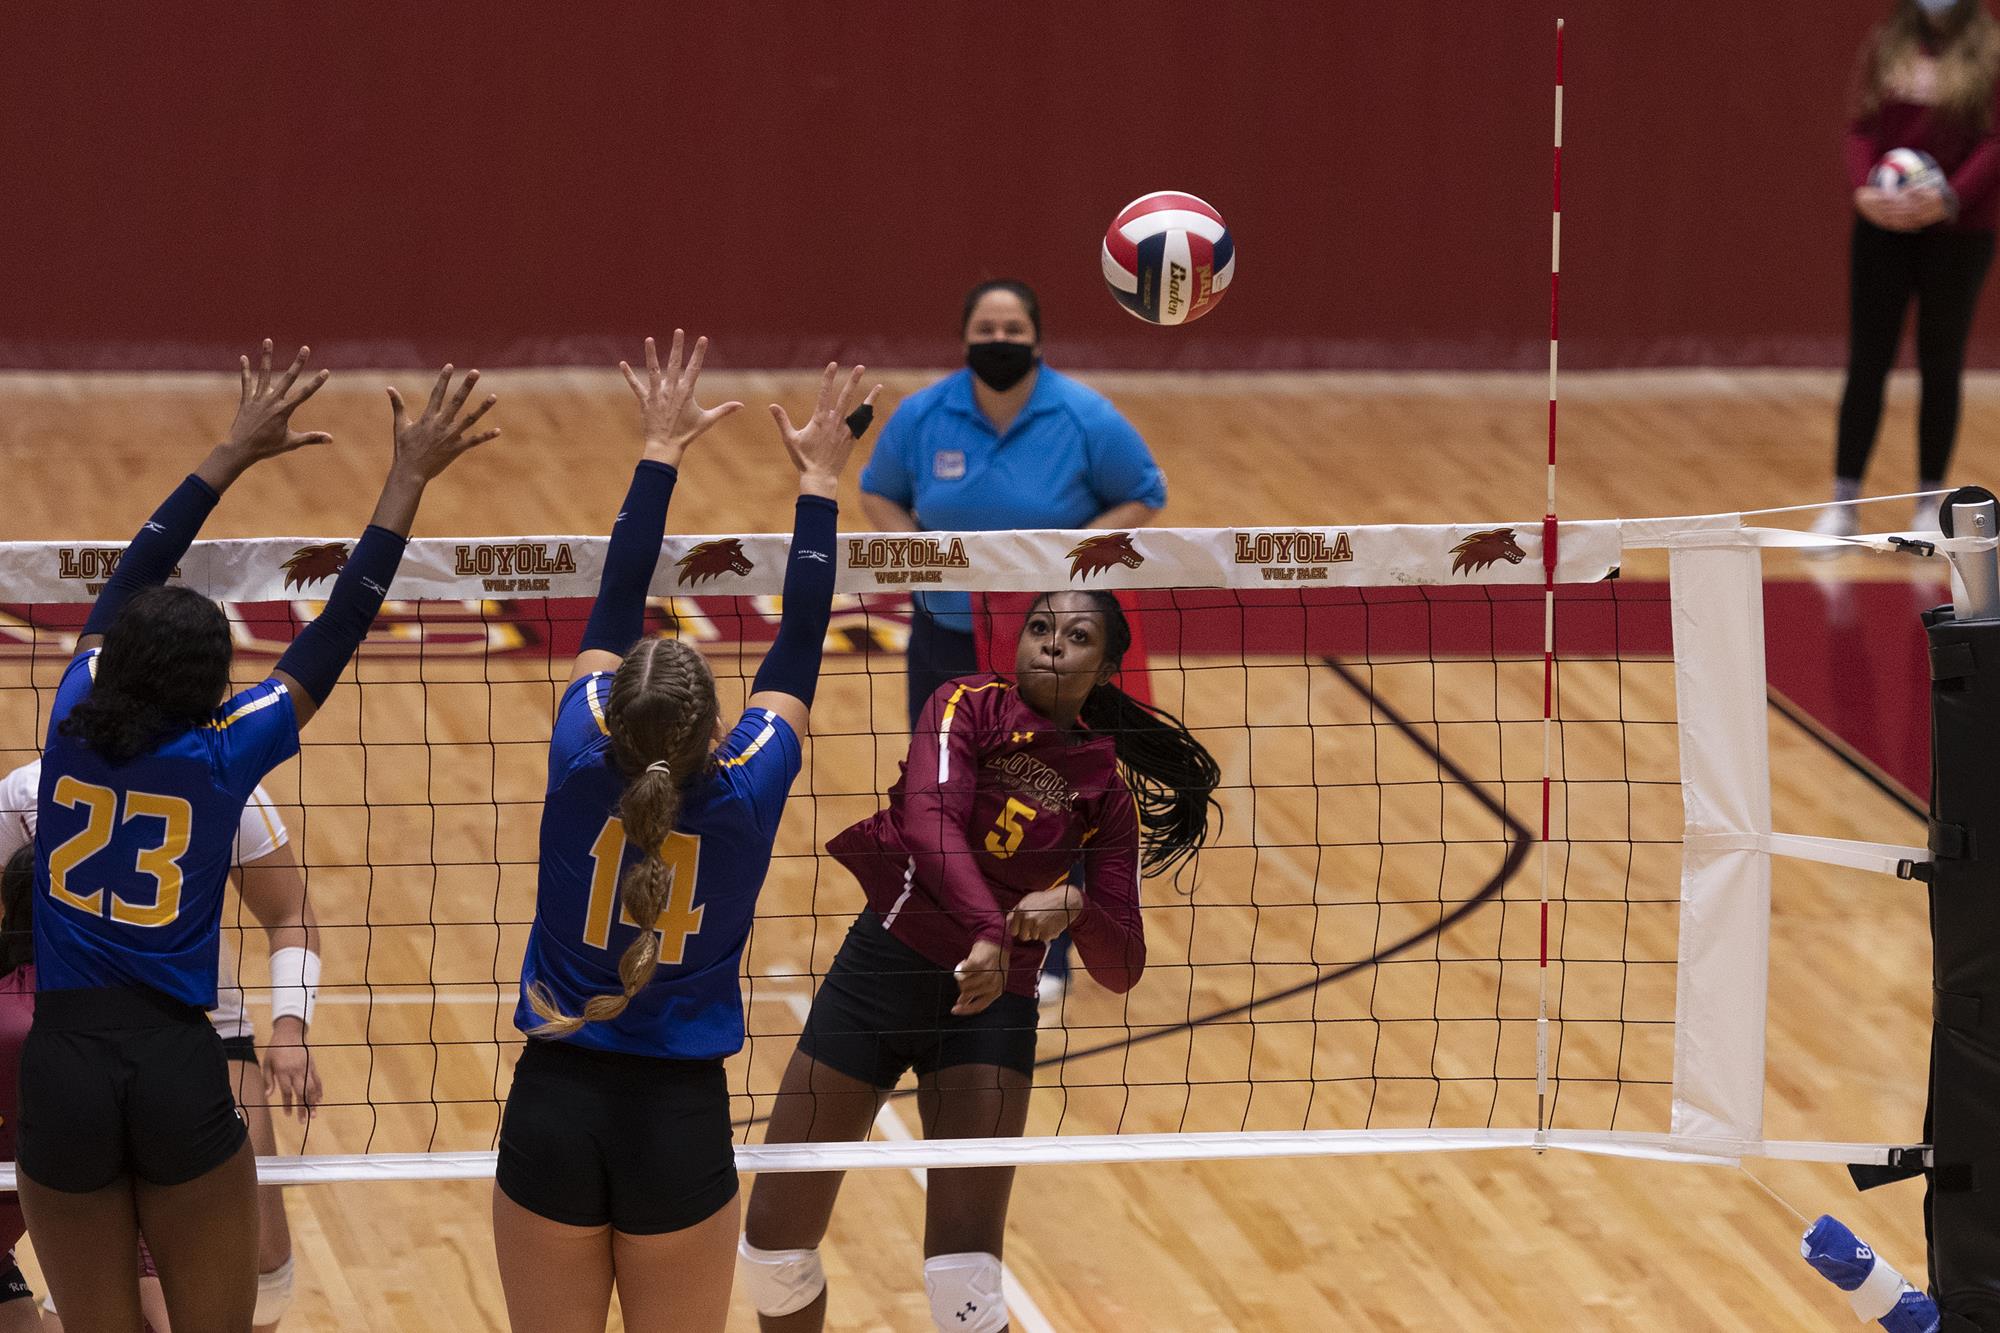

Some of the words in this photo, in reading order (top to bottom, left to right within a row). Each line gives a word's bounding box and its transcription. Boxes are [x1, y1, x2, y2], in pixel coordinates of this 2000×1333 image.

[1168, 262, 1186, 315] Baden
[455, 543, 576, 575] LOYOLA
[848, 538, 969, 568] LOYOLA
[1235, 532, 1353, 563] LOYOLA
[482, 579, 517, 592] WOLF
[517, 578, 550, 591] PACK
[875, 571, 910, 584] WOLF
[910, 570, 942, 583] PACK
[1261, 568, 1296, 580] WOLF
[1296, 567, 1328, 580] PACK
[984, 797, 1037, 859] 5
[48, 774, 192, 928] 23
[582, 814, 706, 965] 14
